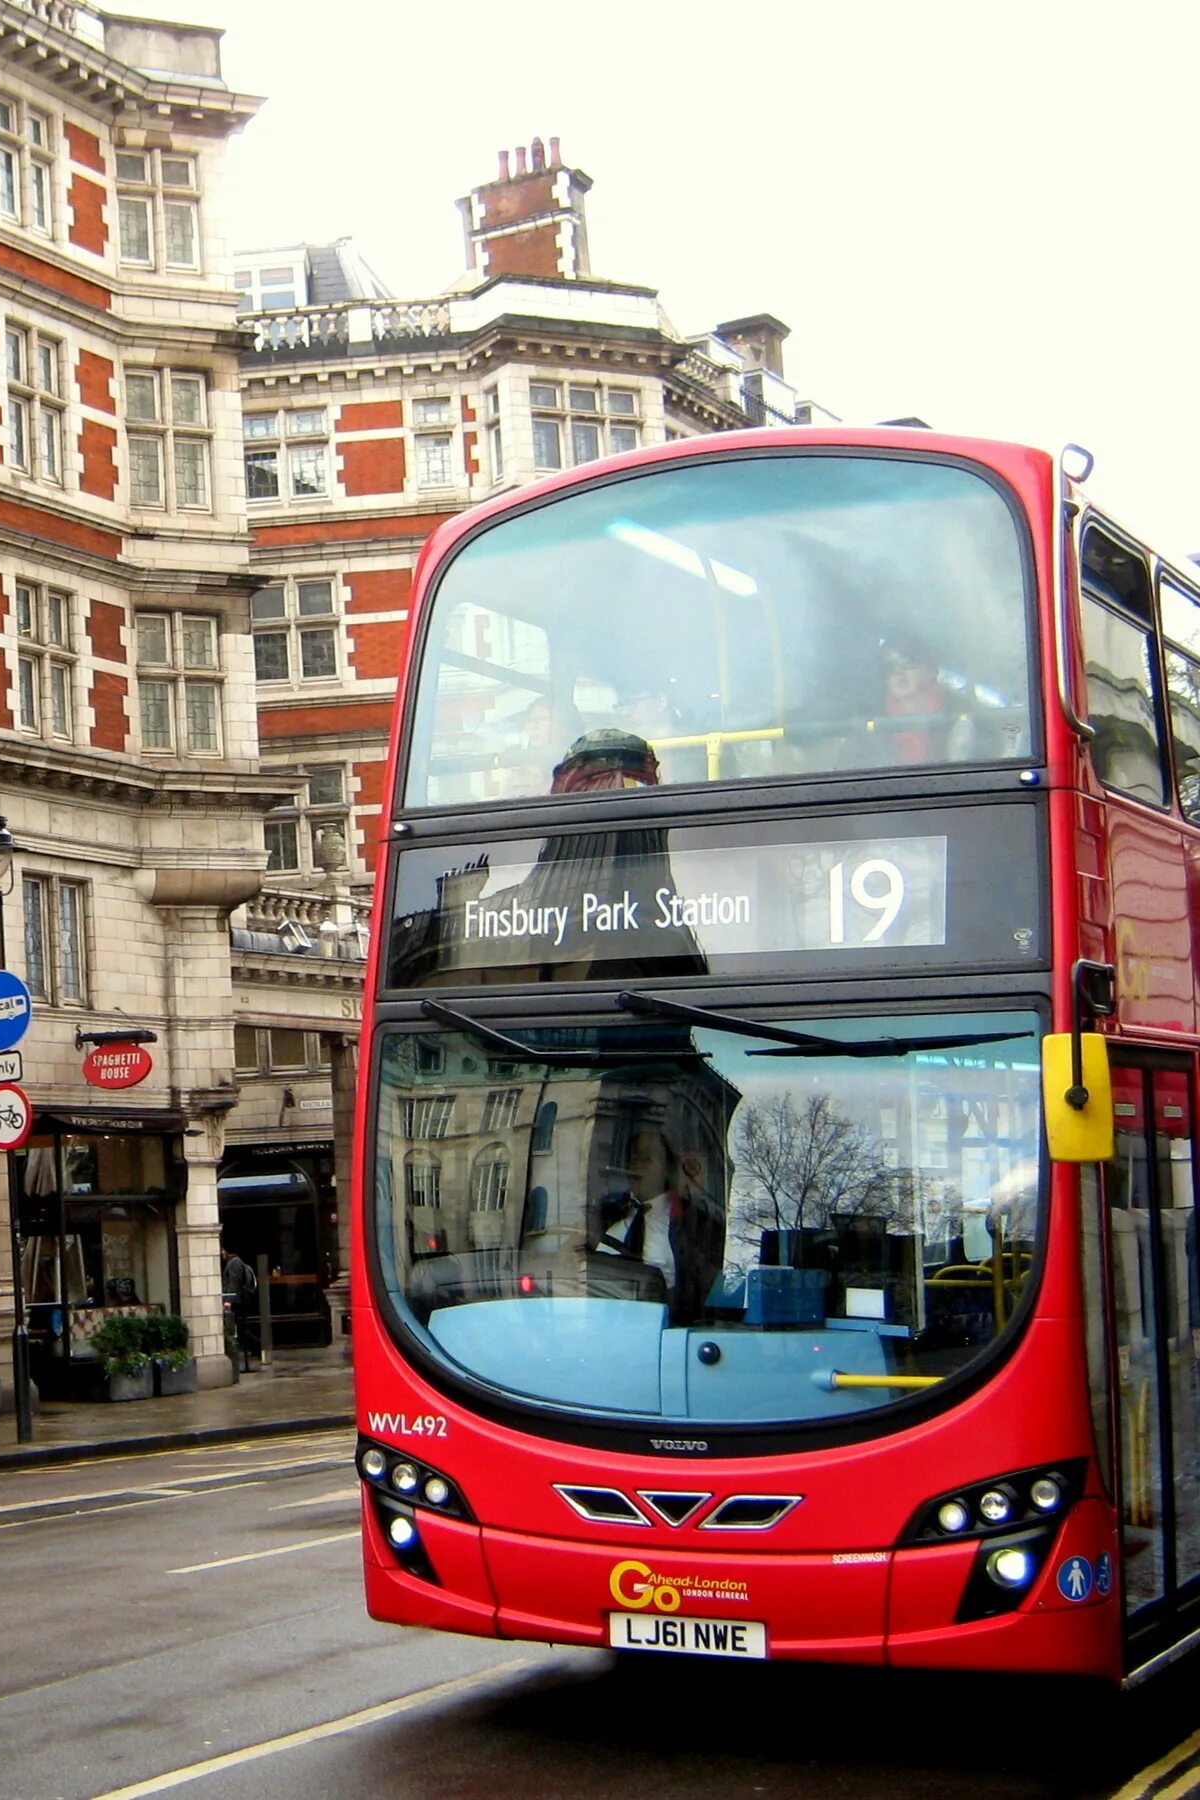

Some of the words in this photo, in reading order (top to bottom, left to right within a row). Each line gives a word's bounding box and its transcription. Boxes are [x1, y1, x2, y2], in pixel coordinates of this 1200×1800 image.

[464, 898, 569, 946] Finsbury
[582, 890, 639, 932] Park
[654, 887, 751, 929] Station
[829, 859, 905, 944] 19
[341, 998, 363, 1019] SI
[92, 1053, 140, 1067] SPAGHETTI
[100, 1067, 130, 1080] HOUSE
[367, 1411, 448, 1437] WVL492
[649, 1439, 708, 1451] VOLVO
[832, 1552, 886, 1565] SCREENWASH
[609, 1560, 681, 1612] Go
[682, 1588, 714, 1599] LONDON
[715, 1590, 749, 1601] GENERAL
[626, 1618, 686, 1648] LJ61
[694, 1623, 748, 1652] NWE
